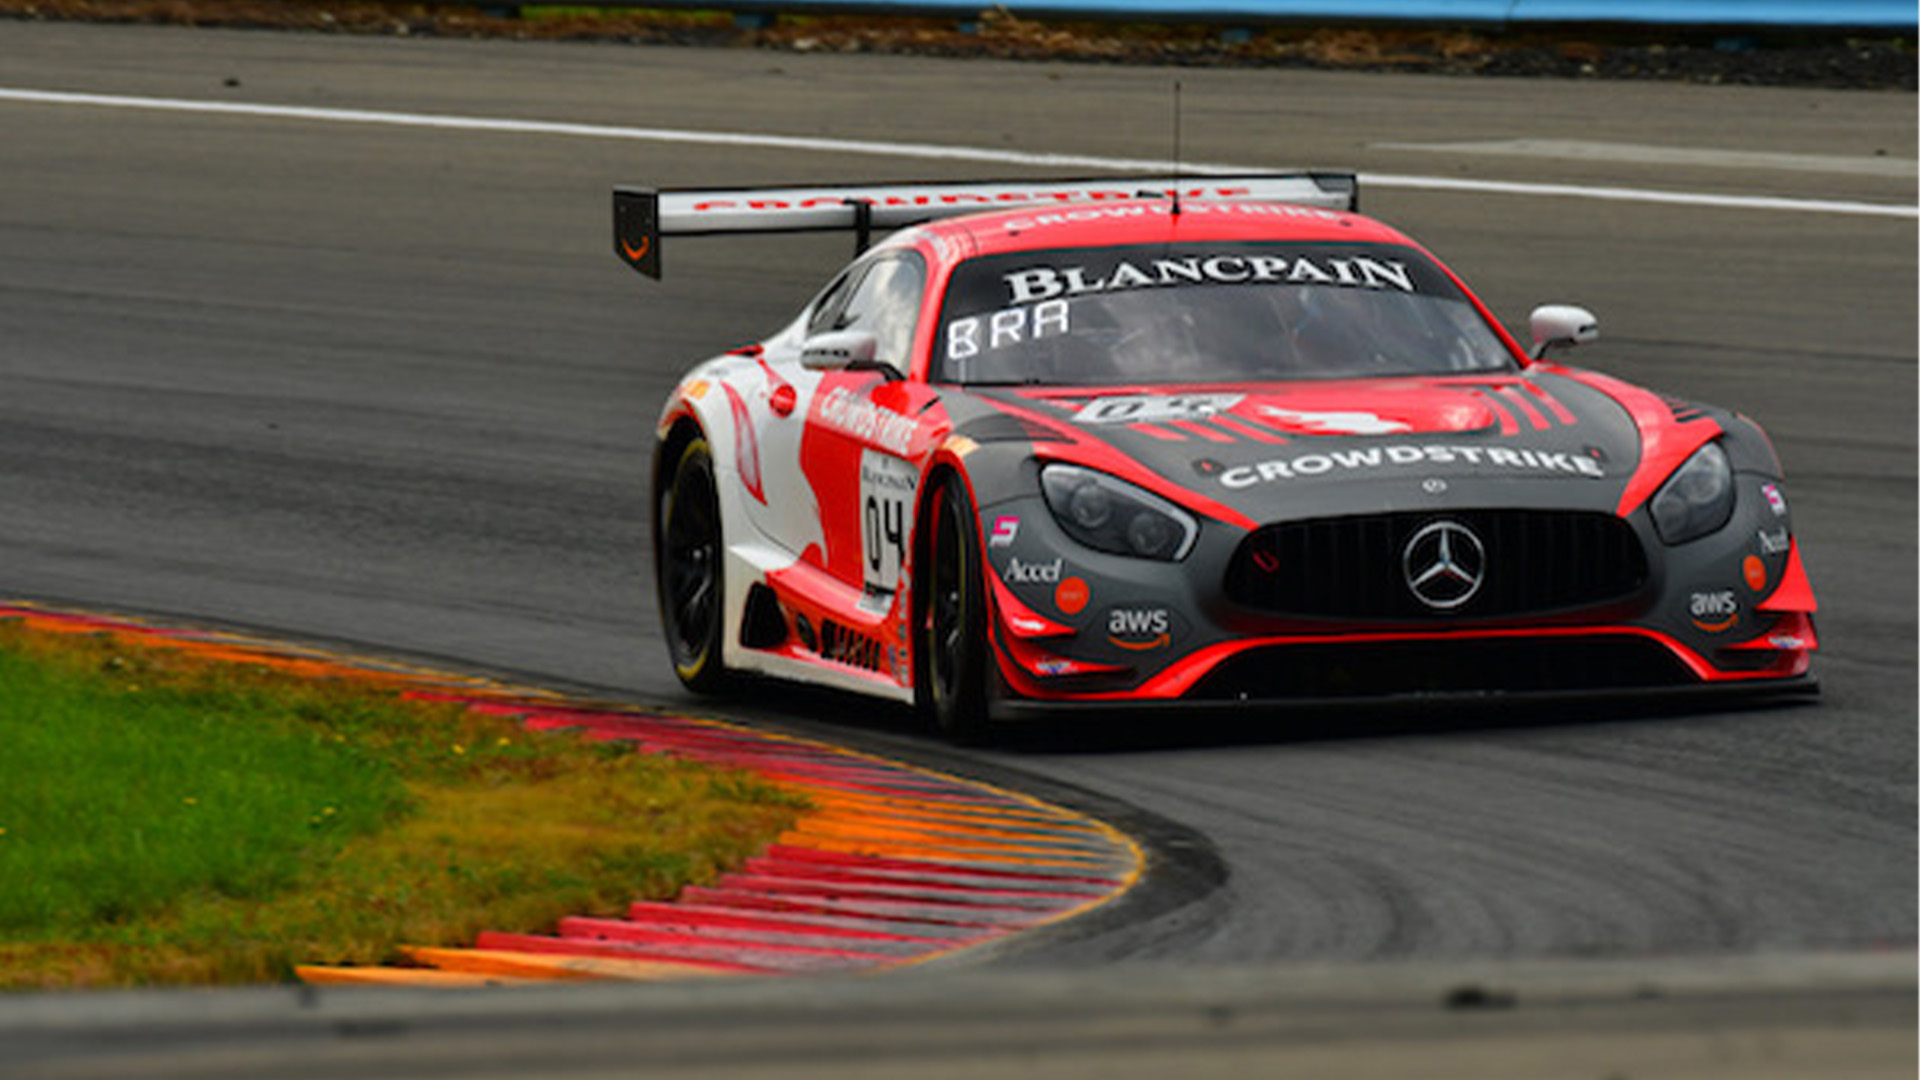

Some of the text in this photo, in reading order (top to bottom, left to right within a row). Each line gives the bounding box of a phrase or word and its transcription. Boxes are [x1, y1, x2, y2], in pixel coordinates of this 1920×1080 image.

[1004, 254, 1415, 304] BLANCPAIN
[947, 299, 1071, 361] BRA
[1219, 445, 1604, 489] CROWDSTRIKE
[866, 495, 905, 572] 04
[1108, 608, 1169, 634] aws
[1691, 591, 1738, 616] aws
